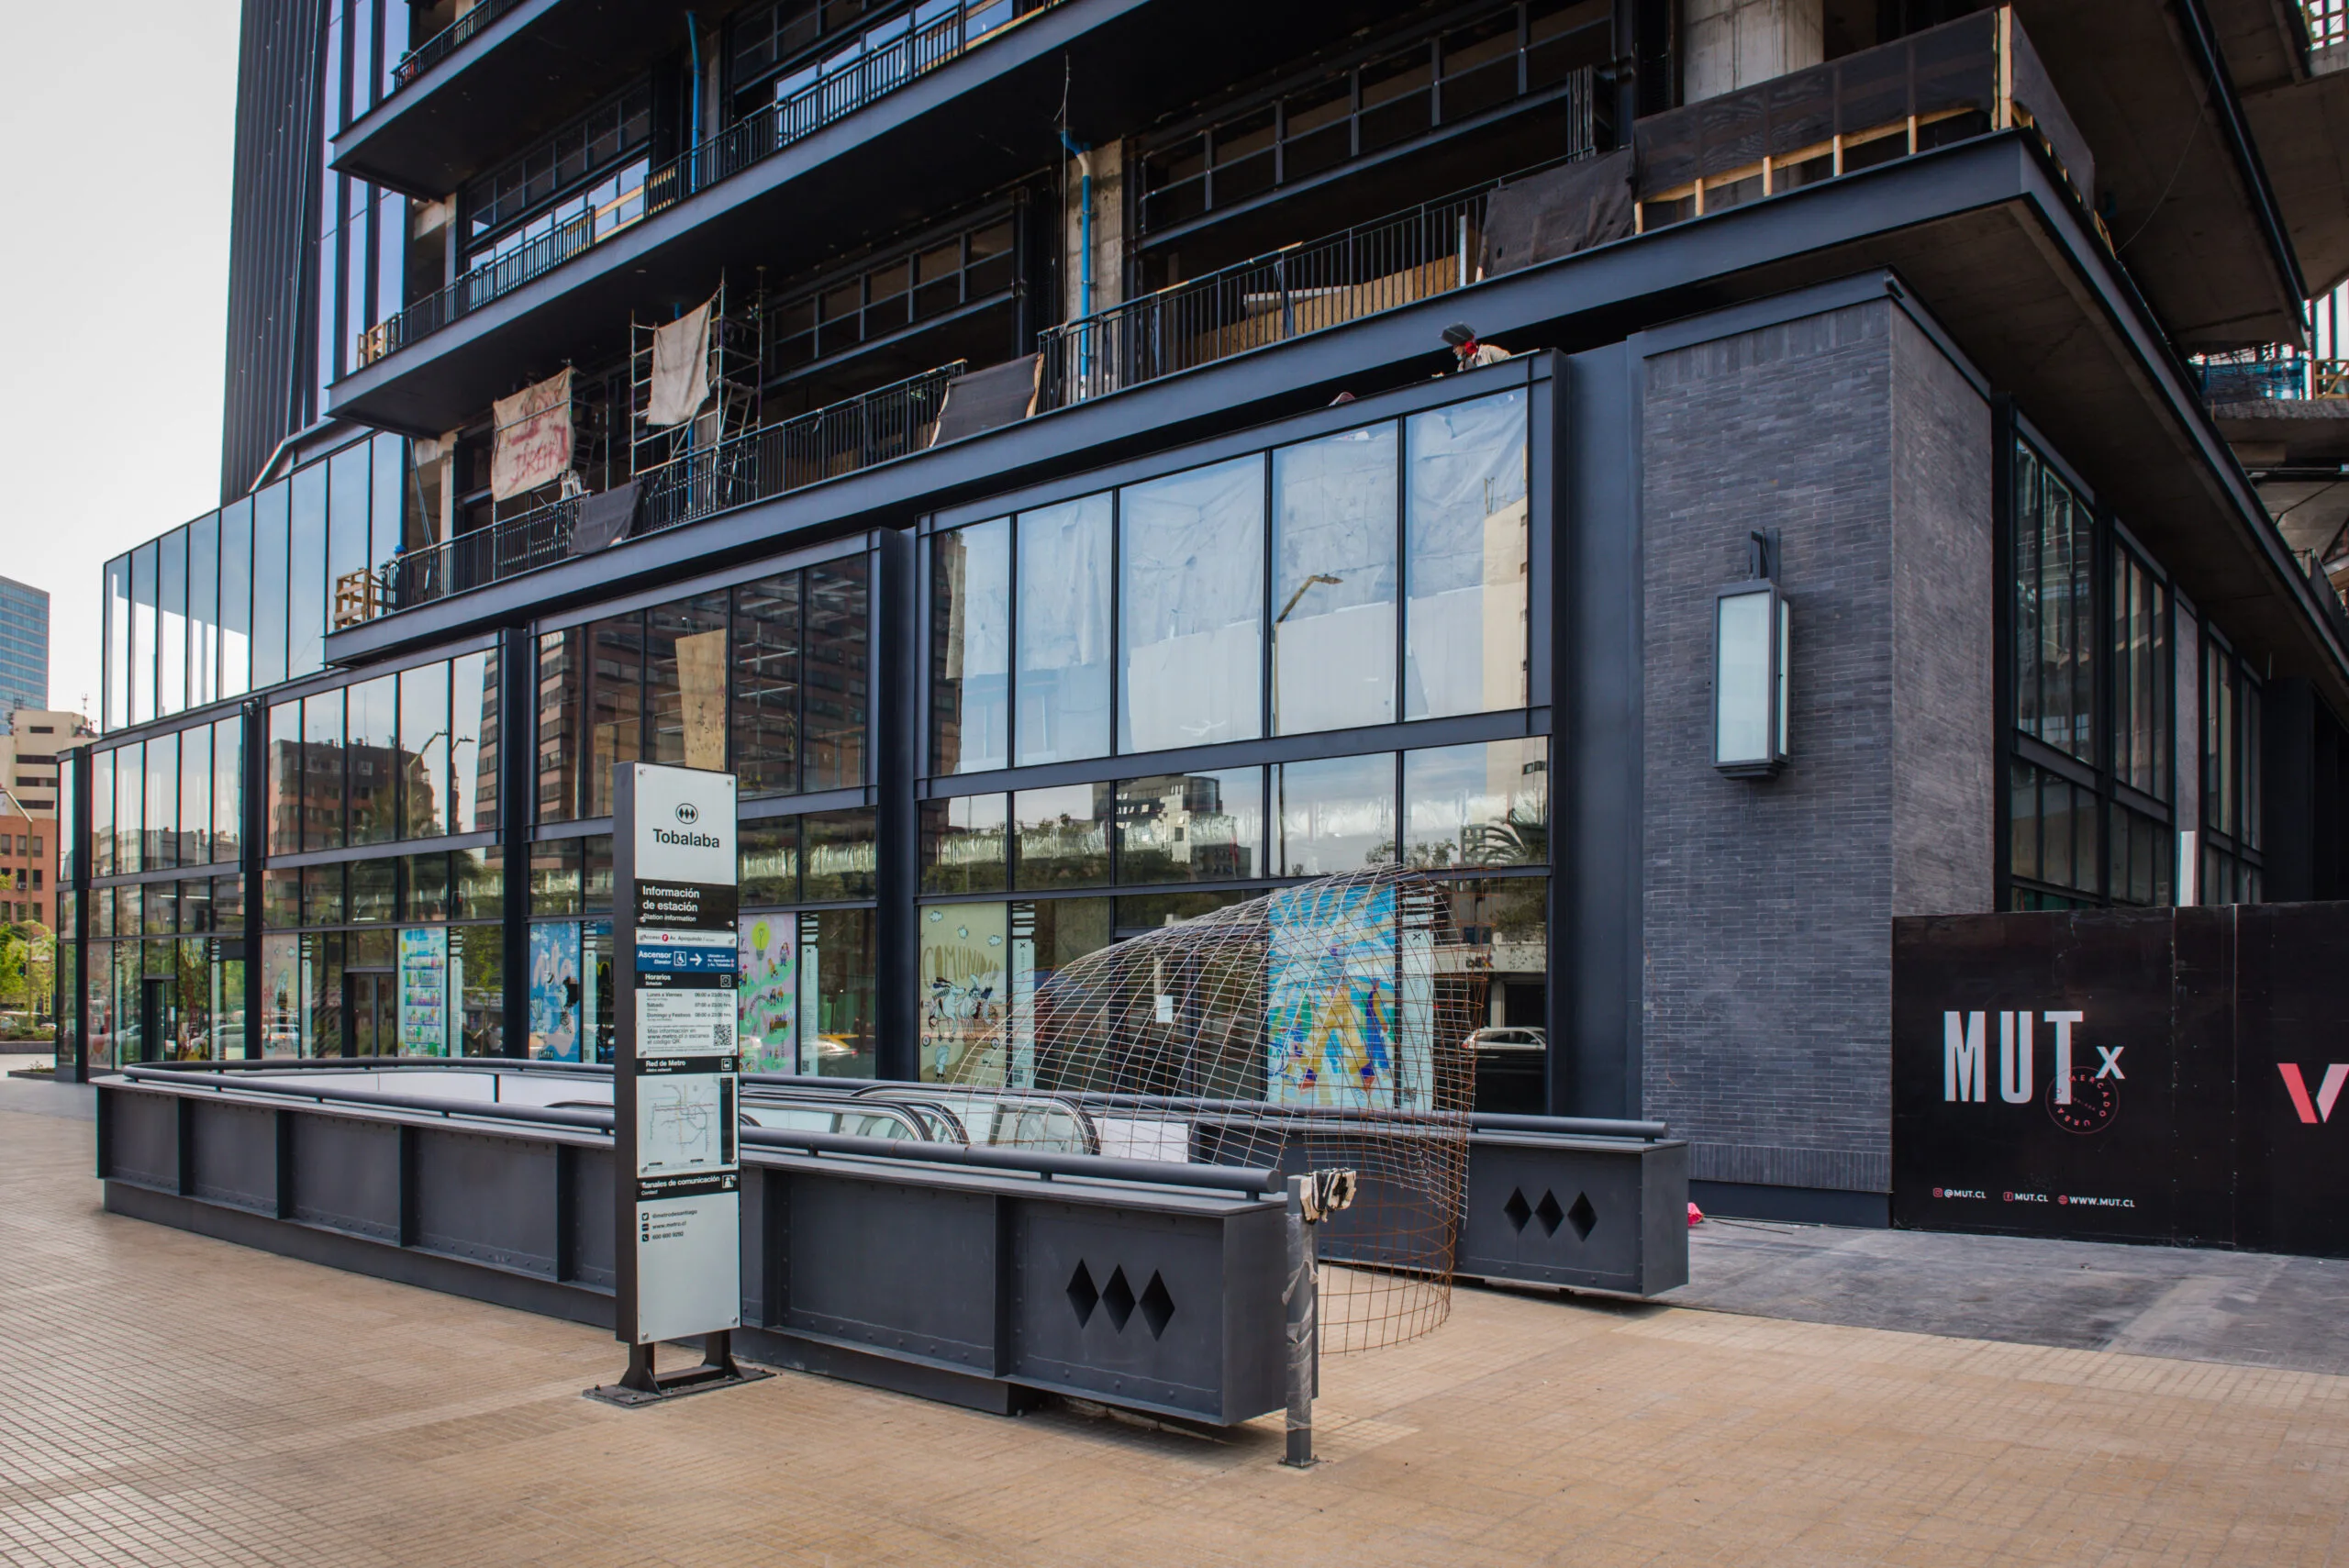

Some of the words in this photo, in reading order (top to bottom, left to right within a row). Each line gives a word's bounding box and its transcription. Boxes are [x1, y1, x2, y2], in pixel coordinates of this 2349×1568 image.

[653, 828, 719, 848] Tobalaba
[642, 885, 700, 899] Información
[642, 900, 655, 910] de
[657, 901, 698, 912] estación
[664, 914, 696, 922] information
[639, 951, 673, 959] Ascensor
[922, 944, 1000, 988] COMUNIDAD
[1943, 1010, 2084, 1105] MUT
[677, 1175, 720, 1185] comunicación
[1943, 1188, 1987, 1200] @MUT.CL
[2014, 1193, 2049, 1203] MUT.CL
[2069, 1195, 2136, 1208] WWW.MUT.CL
